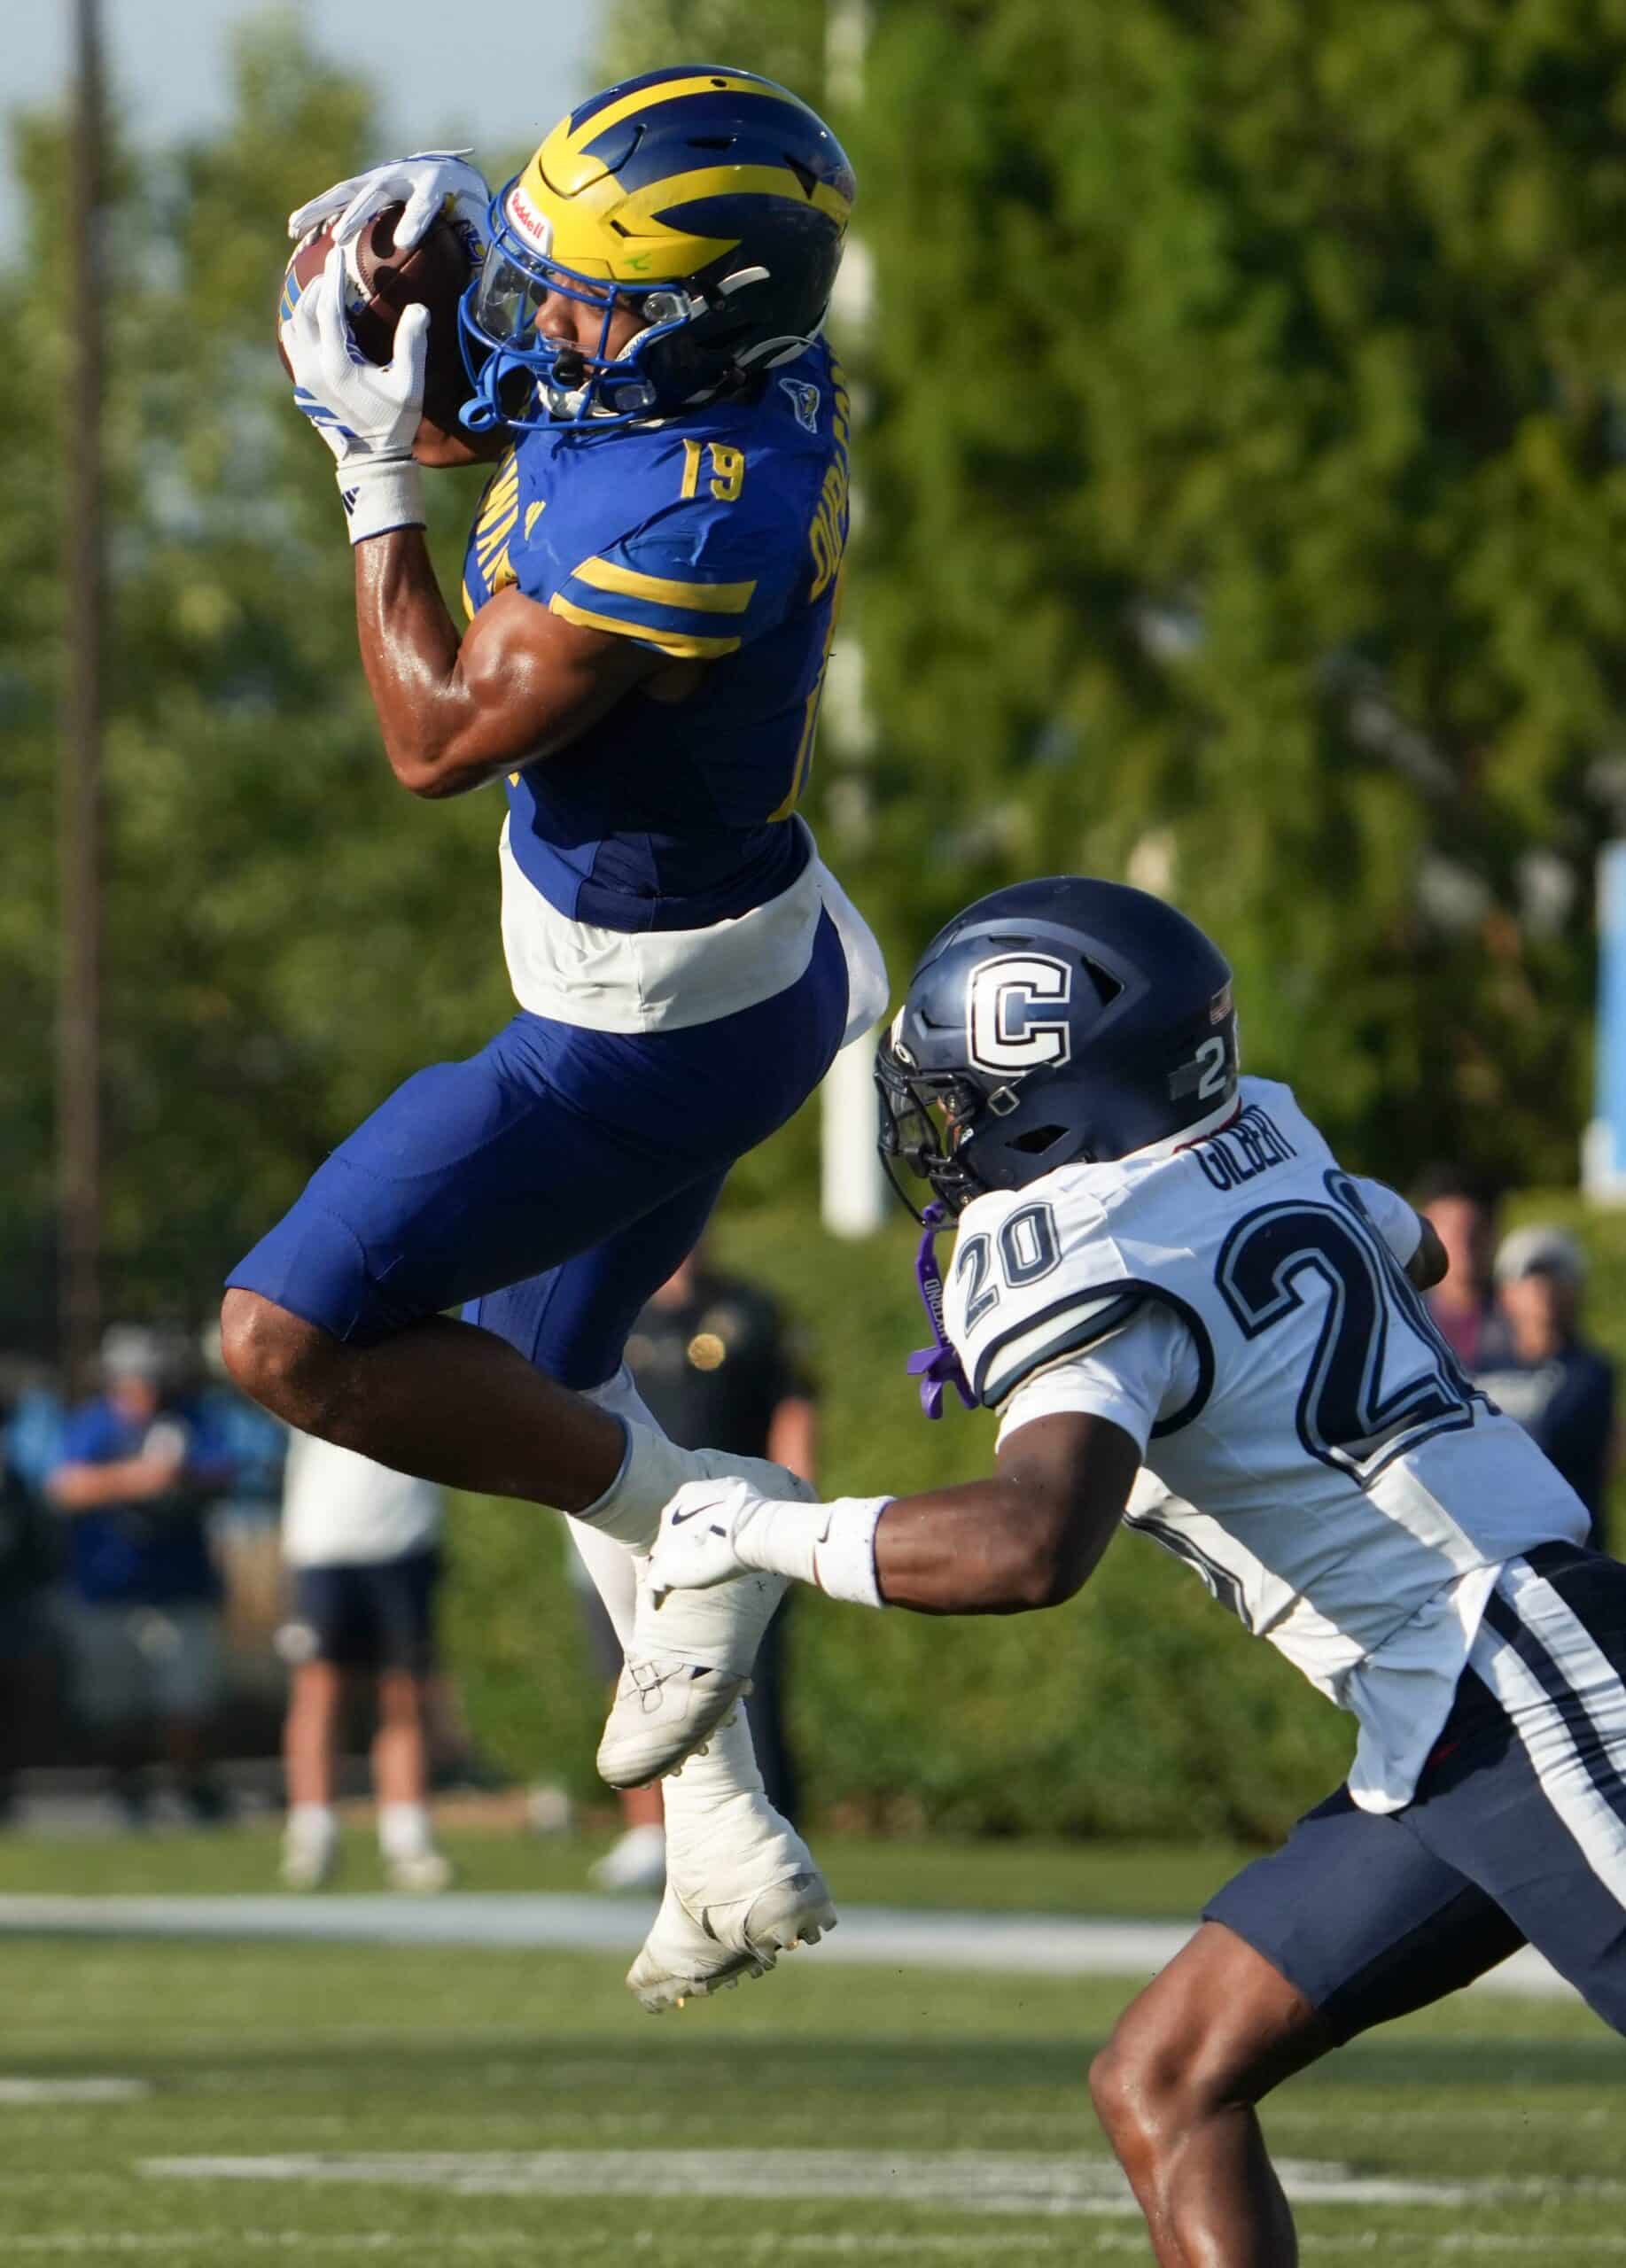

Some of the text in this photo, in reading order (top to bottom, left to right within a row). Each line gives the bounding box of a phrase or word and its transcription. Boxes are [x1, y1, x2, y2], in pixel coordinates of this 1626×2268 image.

[511, 190, 544, 238] Riddell
[681, 439, 744, 501] 19
[966, 951, 1072, 1077] C
[1190, 1105, 1297, 1191] GILBERT
[956, 1201, 1062, 1340] 20
